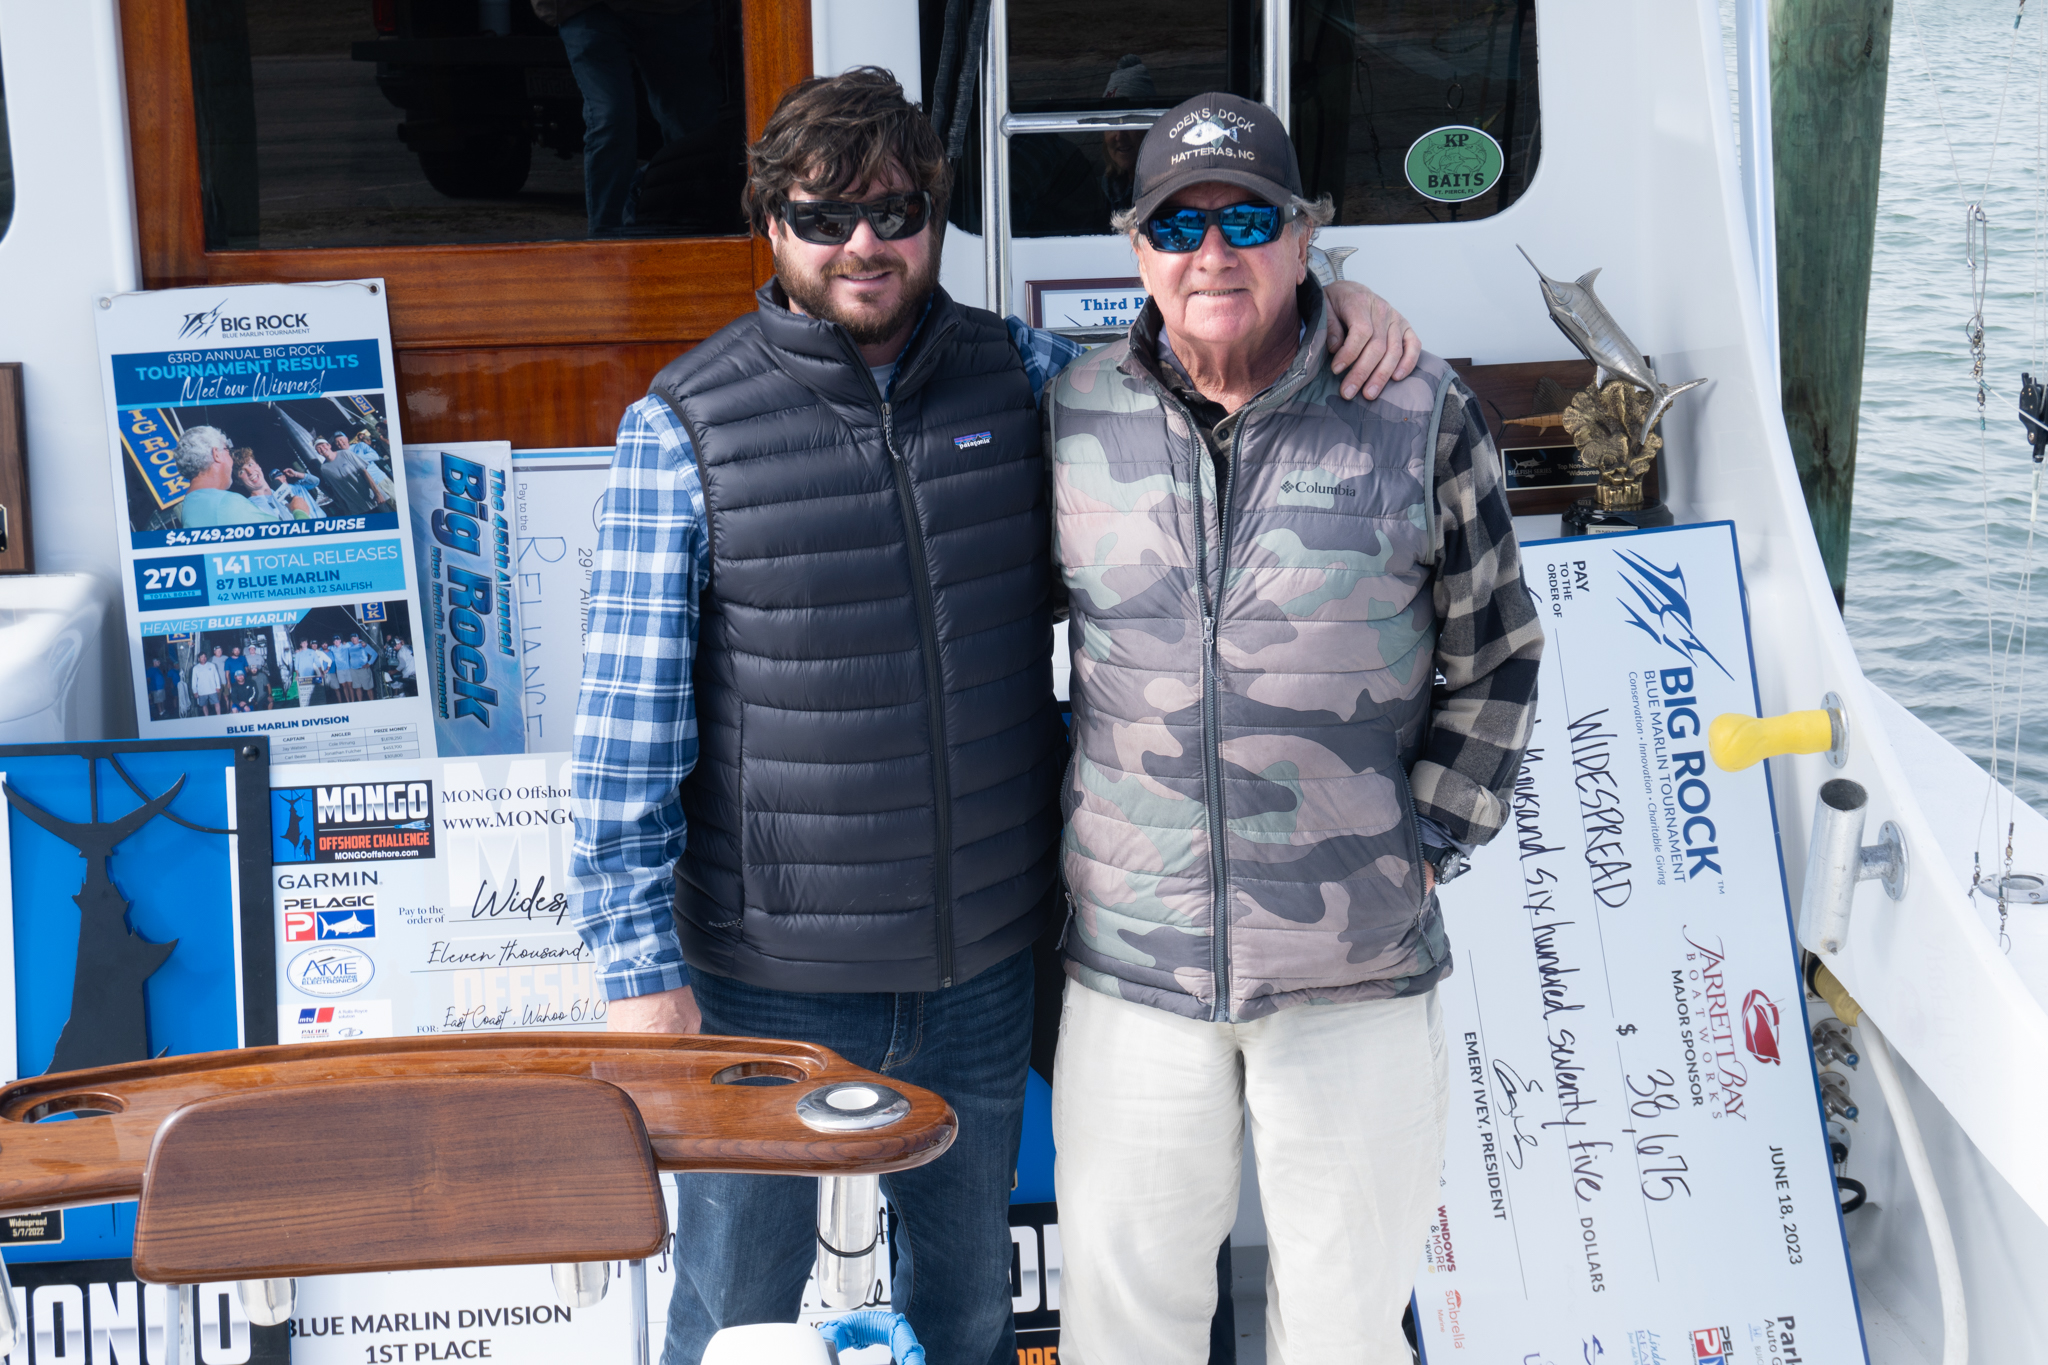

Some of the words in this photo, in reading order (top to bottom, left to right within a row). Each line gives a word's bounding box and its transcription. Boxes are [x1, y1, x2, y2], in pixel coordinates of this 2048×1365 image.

[1169, 108, 1211, 139] ODEN'S
[1218, 108, 1256, 133] DOCK
[1444, 133, 1469, 148] KP
[1171, 147, 1237, 165] HATTERAS,
[1238, 149, 1255, 161] NC
[1428, 172, 1485, 188] BAITS
[1080, 297, 1128, 311] Third
[221, 316, 252, 332] BIG
[256, 313, 309, 330] ROCK
[239, 330, 264, 338] MARLIN
[265, 328, 310, 336] TOURNAMENT
[135, 359, 272, 381] TOURNAMENT
[277, 354, 360, 373] RESULTS
[167, 352, 202, 365] 63RD
[205, 348, 261, 362] ANNUAL
[263, 346, 286, 358] BIG
[289, 344, 326, 356] ROCK
[180, 375, 228, 407] Meet
[224, 384, 249, 397] our
[252, 370, 326, 402] Winners!
[959, 438, 990, 450] patagonia
[1507, 468, 1532, 476] BILLFISH
[489, 468, 507, 510] The
[519, 483, 528, 501] Pay
[1295, 481, 1356, 497] Columbia
[431, 452, 488, 556] Big
[520, 503, 527, 513] to
[166, 525, 255, 546] $4,749,200
[259, 521, 310, 538] TOTAL
[314, 517, 366, 533] PURSE
[520, 514, 528, 531] the
[492, 513, 510, 568] 45th
[213, 554, 251, 576] 141
[254, 551, 310, 570] TOTAL
[314, 545, 398, 566] RELEASES
[430, 545, 442, 580] Blue
[1559, 562, 1568, 578] TO
[143, 565, 197, 590] 270
[216, 578, 234, 590] 87
[238, 575, 278, 589] BLUE
[282, 570, 340, 585] MARLIN
[1547, 563, 1560, 601] ORDER
[1572, 560, 1590, 592] PAY
[217, 593, 229, 602] 42
[231, 589, 266, 601] WHITE
[267, 587, 307, 599] MARLIN
[309, 585, 317, 594] &
[318, 584, 328, 594] 12
[329, 580, 373, 592] SAILFISH
[1561, 580, 1573, 601] THE
[432, 582, 445, 630] Marlin
[495, 572, 515, 657] Annual
[1553, 603, 1563, 618] OF
[143, 618, 206, 635] HEAVIEST
[208, 616, 242, 629] BLUE
[246, 611, 298, 625] MARLIN
[447, 565, 499, 729] Rock
[435, 633, 450, 720] Tournament
[1644, 670, 1661, 708] BLUE
[1659, 665, 1701, 739] BIG
[226, 724, 255, 735] BLUE
[257, 720, 299, 733] MARLIN
[301, 715, 349, 728] DIVISION
[1651, 710, 1669, 770] MARLIN
[1628, 671, 1645, 734] Conservation
[1638, 743, 1653, 795] Innovation
[1647, 803, 1661, 853] Charitable
[1655, 855, 1666, 886] Giving
[316, 783, 429, 824] MONGO
[441, 787, 511, 803] MONGO
[517, 785, 572, 800] Offshor
[1567, 708, 1632, 908] WIDESPREAD
[1672, 750, 1723, 880] ROCK
[1659, 772, 1686, 883] TOURNAMENT
[319, 834, 371, 850] OFFSHORE
[374, 832, 430, 848] CHALLENGE
[334, 849, 419, 861] MONGOoffshore.com
[277, 871, 378, 890] GARMIN
[284, 895, 374, 910] PELAGIC
[399, 906, 415, 917] Pay
[429, 905, 444, 914] the
[407, 916, 432, 925] order
[434, 915, 444, 924] of
[427, 941, 495, 965] Eleven
[303, 959, 357, 977] AME
[416, 1025, 439, 1034] FOR:
[443, 1006, 469, 1031] East
[522, 1002, 567, 1026] Wahoo
[1616, 1023, 1638, 1037] $
[1671, 969, 1690, 1027] MAJOR
[1681, 1030, 1704, 1106] SPONSOR
[1464, 1032, 1485, 1086] EMERY
[1473, 1089, 1491, 1129] IVEY,
[1480, 1132, 1507, 1221] PRESIDENT
[1769, 1145, 1790, 1190] JUNE
[1778, 1195, 1794, 1220] 18,
[9, 1216, 48, 1228] Widespread
[1437, 1205, 1456, 1273] WINDOWS
[1783, 1223, 1803, 1265] 2023
[1432, 1234, 1446, 1272] MORE
[1580, 1217, 1605, 1293] DOLLARS
[290, 1316, 344, 1337] BLUE
[351, 1309, 452, 1334] MARLIN
[458, 1304, 572, 1329] DIVISION
[1437, 1309, 1446, 1333] Marine
[1445, 1290, 1466, 1349] sunbrella
[1764, 1319, 1778, 1353] Auto
[365, 1343, 409, 1365] 1ST
[415, 1339, 492, 1362] PLACE
